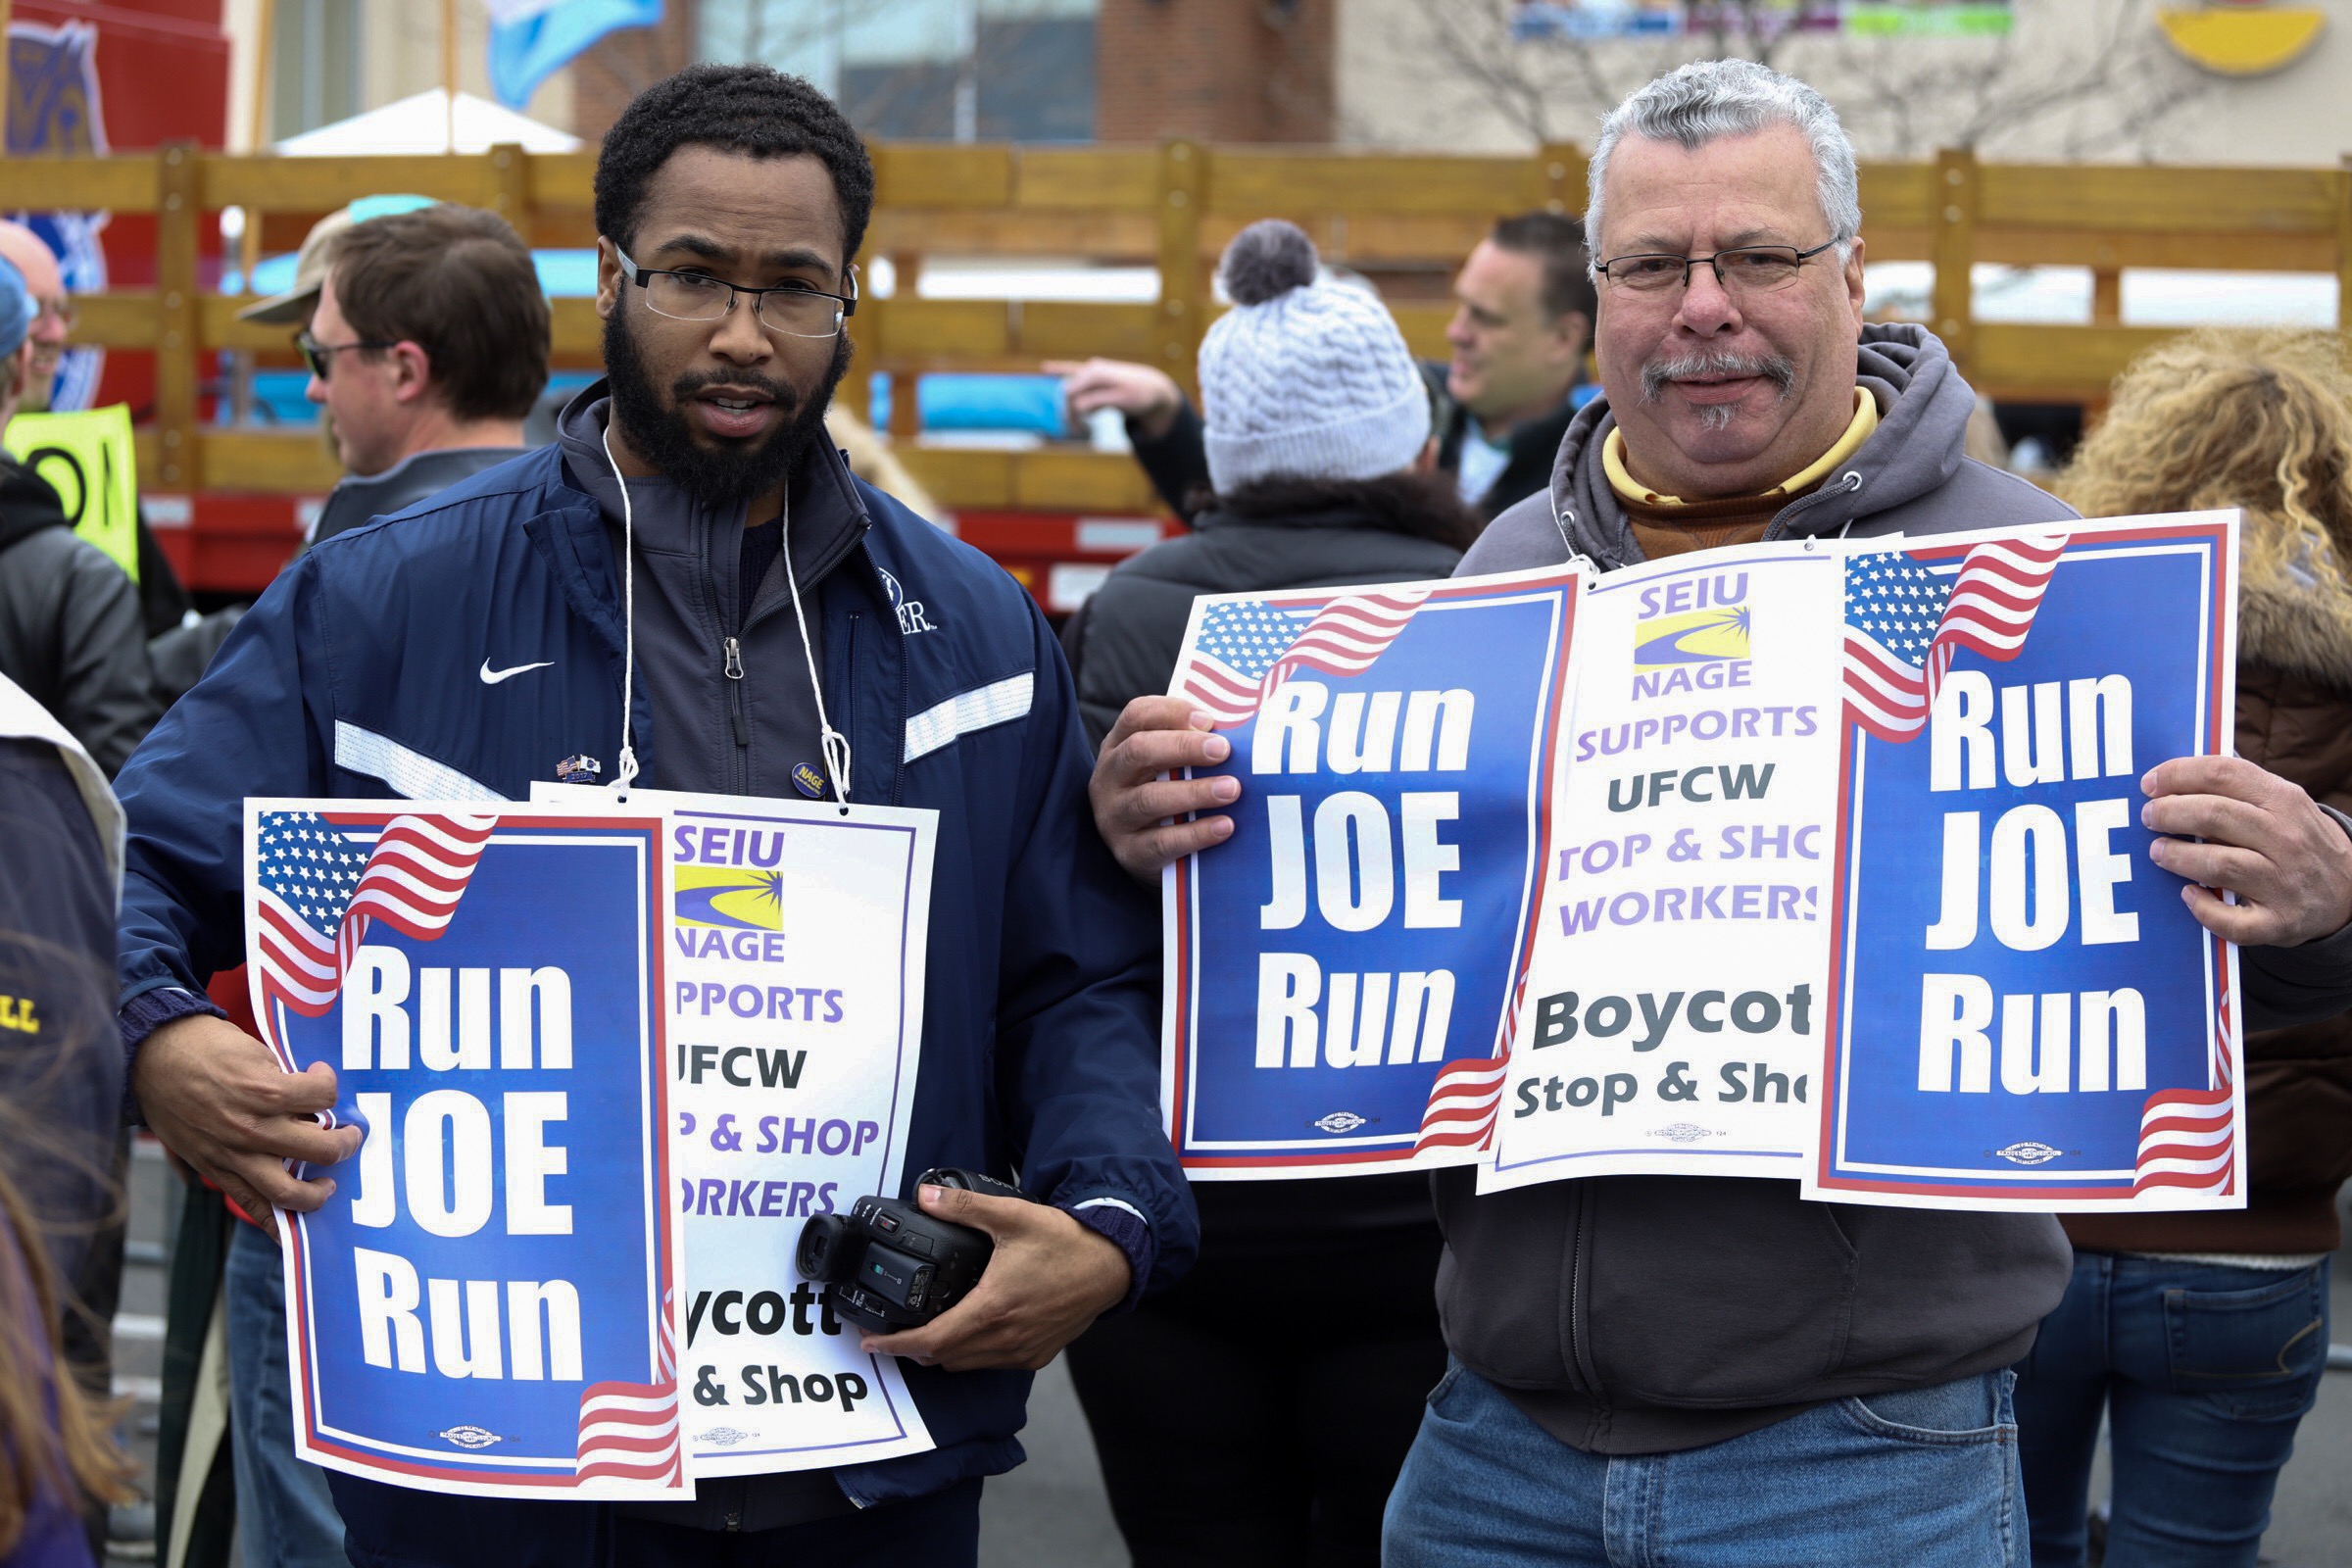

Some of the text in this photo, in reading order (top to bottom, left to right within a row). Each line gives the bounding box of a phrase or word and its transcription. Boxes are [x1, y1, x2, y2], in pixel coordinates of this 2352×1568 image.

[1639, 572, 1748, 619] SEIU
[1631, 660, 1752, 702] NAGE
[1251, 681, 1475, 775] Run
[1576, 706, 1817, 762] SUPPORTS
[1930, 669, 2133, 792] Run
[799, 765, 824, 790] NAGE
[1607, 763, 1776, 812] UFCW
[674, 825, 785, 867] SEIU
[1260, 791, 1462, 932] JOE
[1558, 833, 1651, 881] TOP
[1666, 828, 1702, 862] &
[1926, 798, 2139, 952] JOE
[675, 927, 785, 962] NAGE
[342, 945, 572, 1071] Run
[676, 981, 844, 1023] PPORTS
[1254, 953, 1456, 1069] Run
[1533, 983, 1811, 1053] Boycot
[1917, 973, 2146, 1095] Run
[1514, 1072, 1638, 1118] Stop
[1656, 1060, 1699, 1102] &
[710, 1113, 743, 1152] &
[756, 1115, 879, 1156] SHOP
[351, 1089, 573, 1238] JOE
[681, 1177, 838, 1217] RKERS
[354, 1247, 584, 1382] Run
[685, 1281, 842, 1350] ycott
[693, 1364, 868, 1412] & Shop
